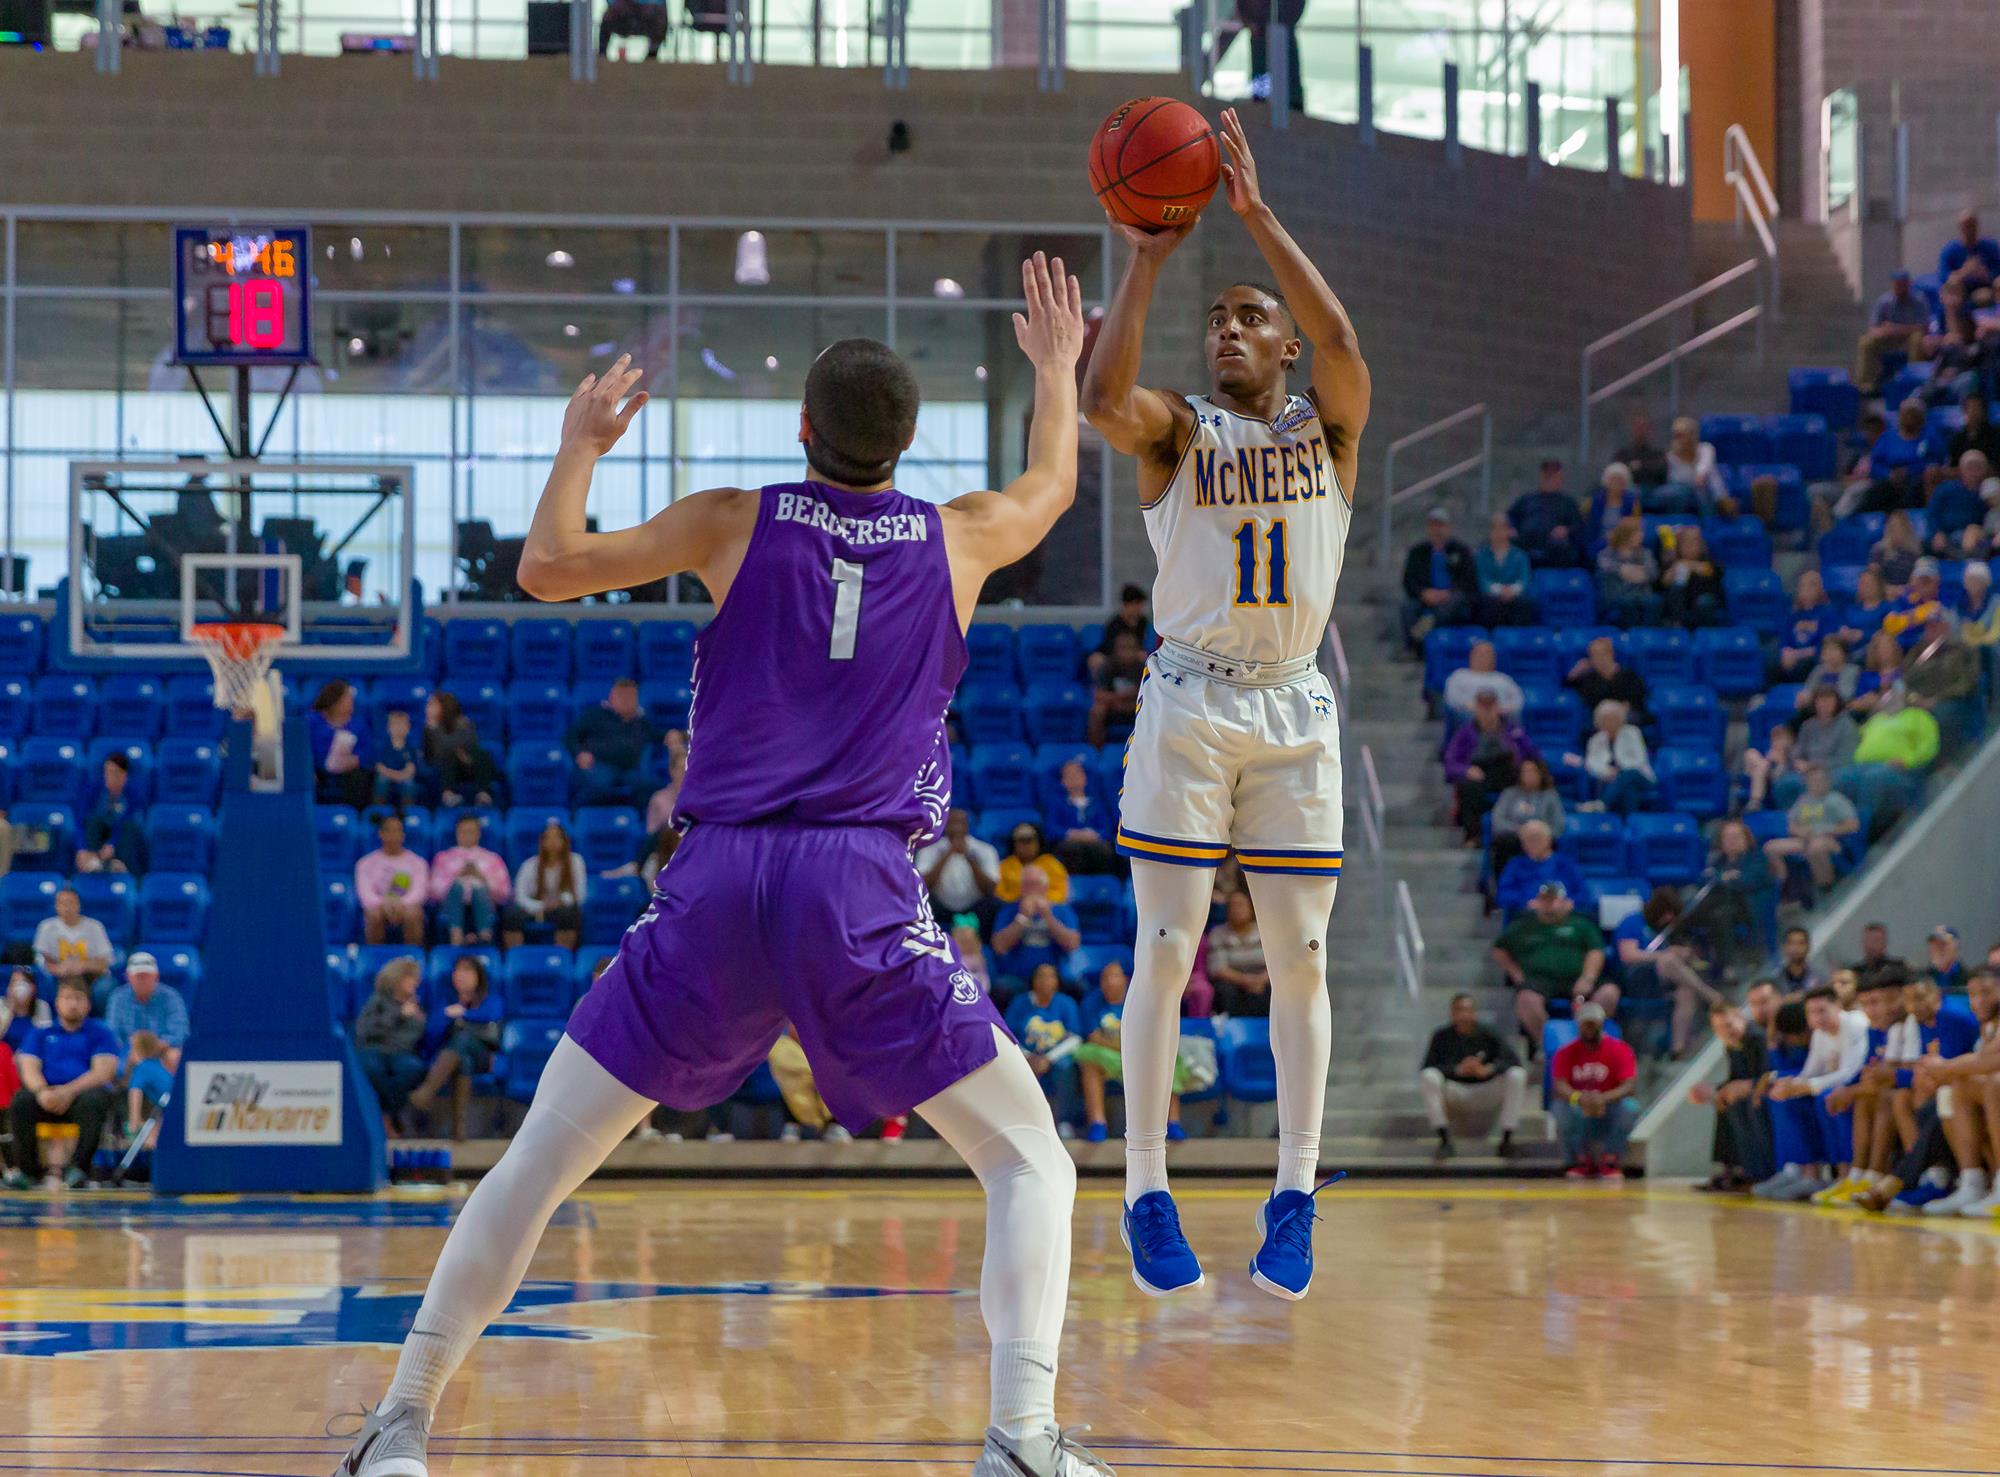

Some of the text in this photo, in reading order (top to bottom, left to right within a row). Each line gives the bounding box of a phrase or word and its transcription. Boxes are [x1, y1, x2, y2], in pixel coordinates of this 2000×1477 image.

[211, 240, 295, 277] 446
[229, 279, 284, 350] 18
[1232, 518, 1291, 608] 11
[829, 557, 864, 660] 1
[202, 1072, 270, 1112] Billy
[227, 1099, 331, 1132] Navarre
